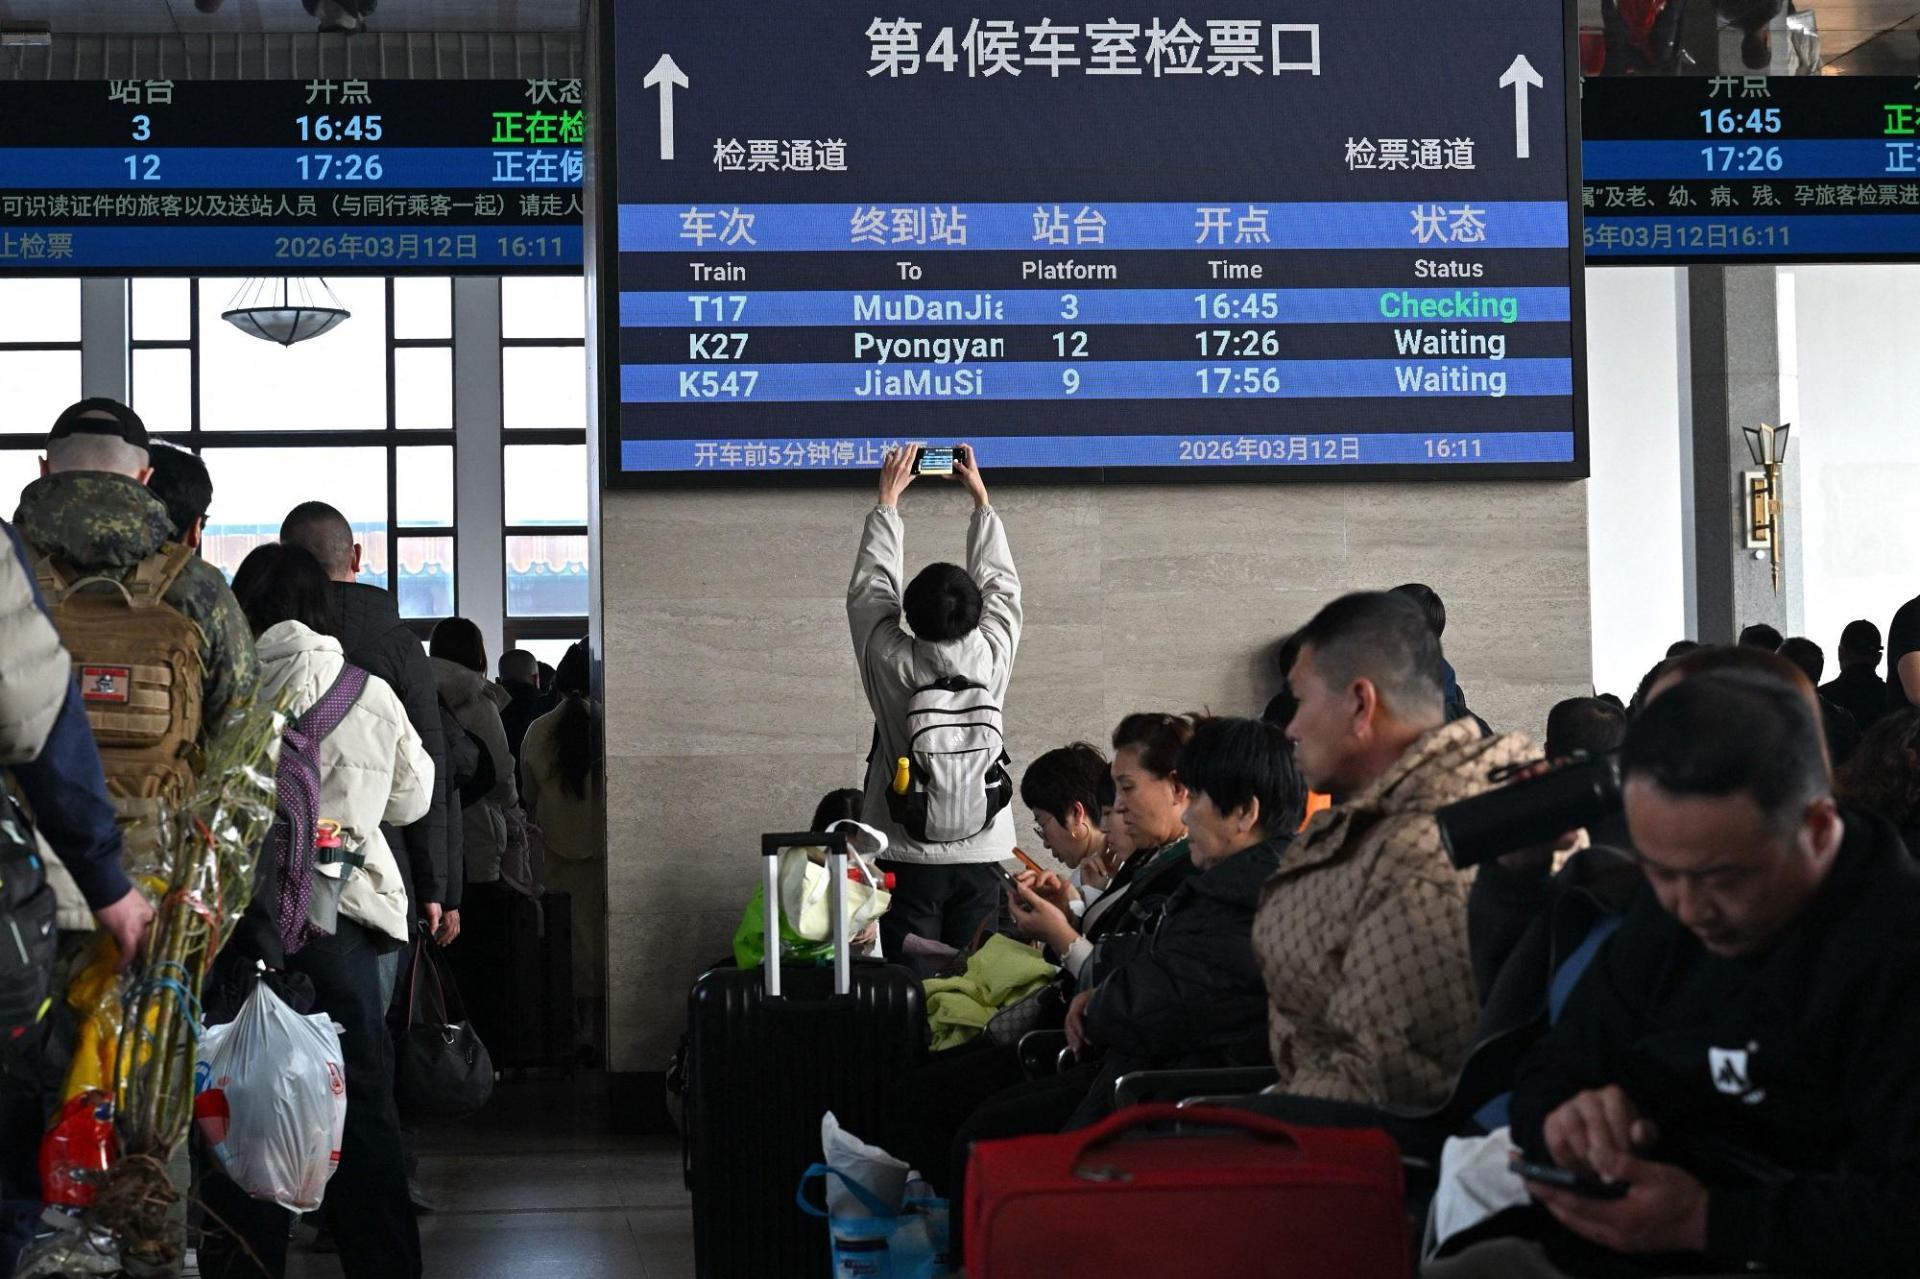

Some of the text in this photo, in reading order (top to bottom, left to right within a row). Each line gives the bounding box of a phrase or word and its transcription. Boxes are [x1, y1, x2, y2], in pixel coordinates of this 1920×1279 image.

[865, 17, 1320, 77] 第4候车室检票口
[133, 115, 150, 140] 3
[297, 116, 381, 140] 16:45
[1699, 105, 1920, 134] 16:45 正
[125, 155, 160, 179] 12
[297, 155, 382, 179] 17:26
[714, 138, 847, 171] 检票通道
[1345, 137, 1475, 170] 检票通道
[1701, 143, 1920, 172] 17:26 正
[680, 205, 1485, 246] 车次 终到站 站台 开点 状态
[276, 234, 560, 258] 2026年03月12日 16:11
[690, 259, 1483, 280] Train To Platform Time Status
[688, 296, 746, 321] T17
[1061, 294, 1078, 319] 3
[1195, 293, 1278, 318] 16:45
[1381, 292, 1517, 322] Checking
[690, 329, 1505, 365] K27 Pyongyan 12 17:26 Waiting
[680, 366, 1506, 397] K547 JiaMuSi 9 17:56 Waiting
[1180, 437, 1358, 460] 2026年03月12日
[1425, 439, 1480, 457] 16:11
